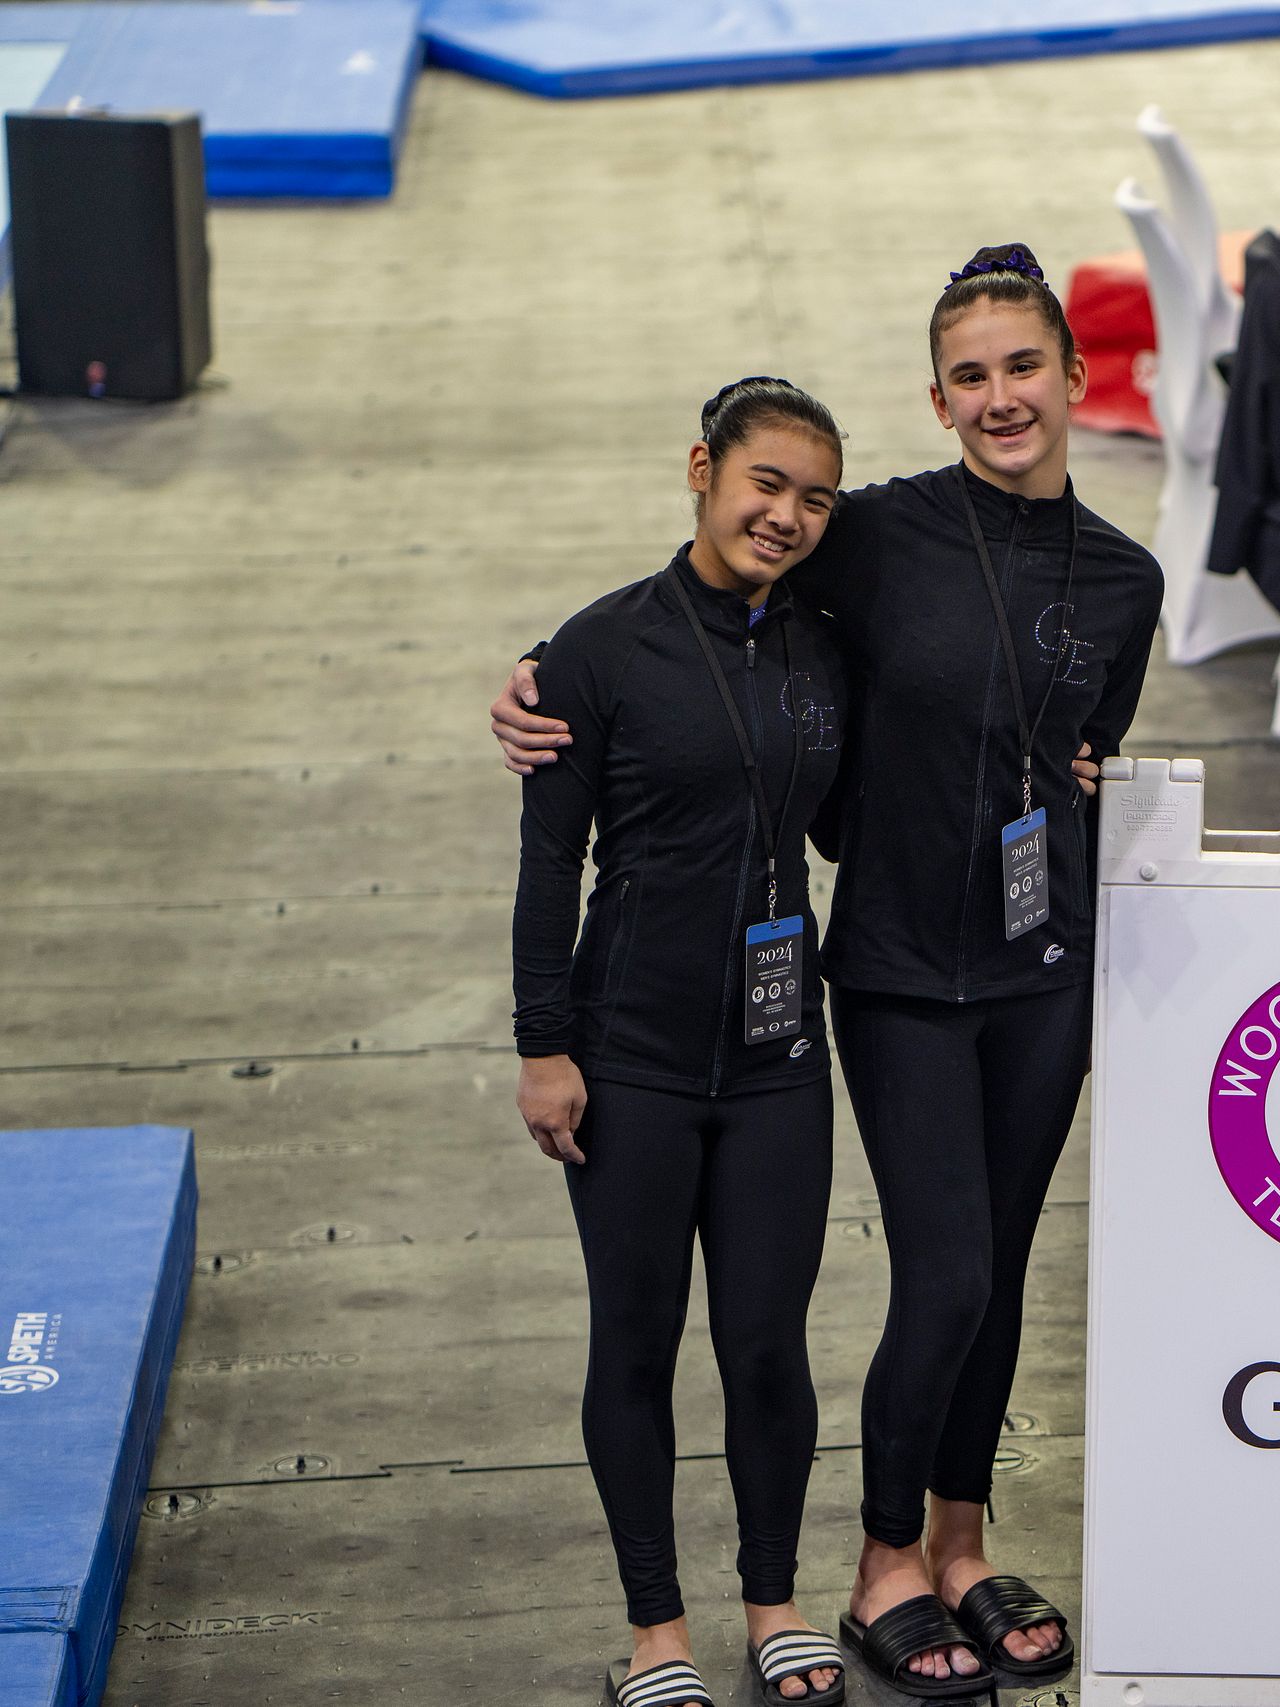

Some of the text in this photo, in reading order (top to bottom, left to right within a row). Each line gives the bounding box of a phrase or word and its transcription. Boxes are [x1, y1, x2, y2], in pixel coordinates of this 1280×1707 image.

[1011, 833, 1040, 863] 2024
[757, 940, 792, 965] 2024
[7, 1312, 47, 1364] SPIETH
